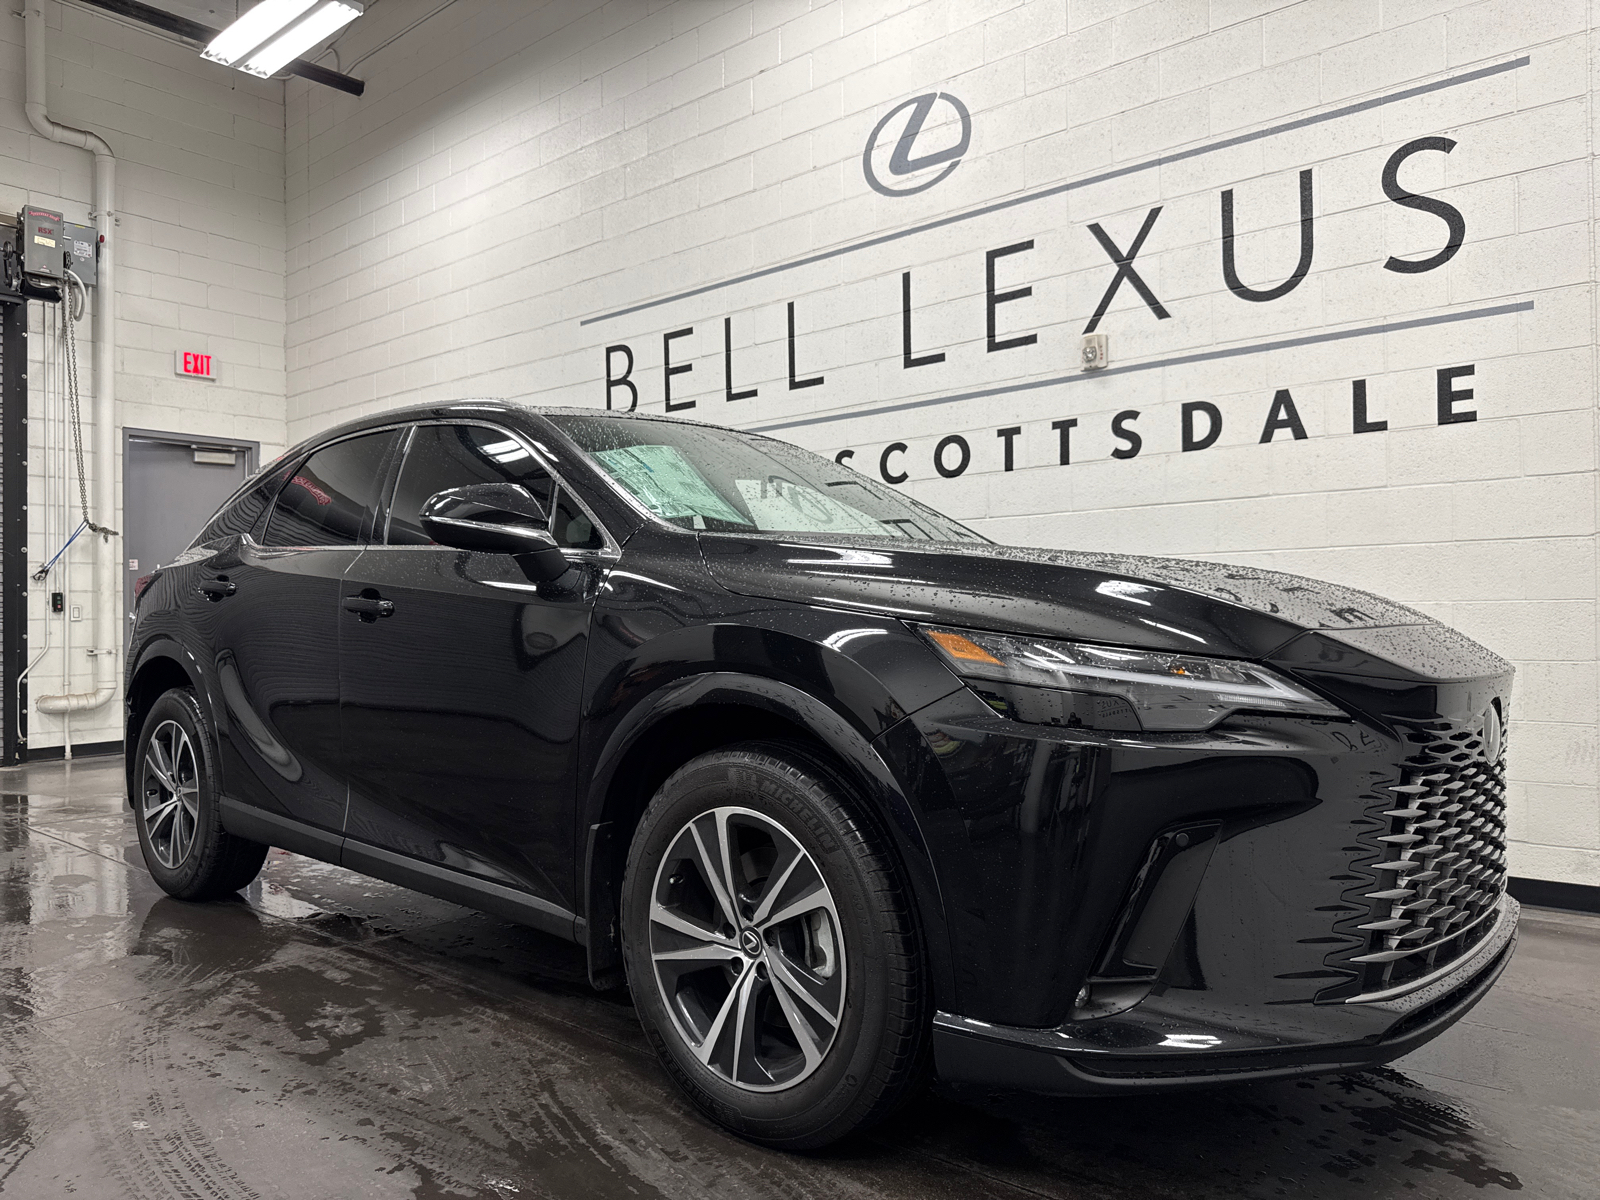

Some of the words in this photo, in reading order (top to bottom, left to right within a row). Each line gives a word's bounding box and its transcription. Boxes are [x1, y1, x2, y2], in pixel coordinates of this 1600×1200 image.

[37, 226, 53, 235] RSX
[605, 301, 825, 413] BELL
[902, 136, 1466, 370] LEXUS
[183, 351, 212, 377] EXIT
[759, 780, 836, 850] MICHELIN
